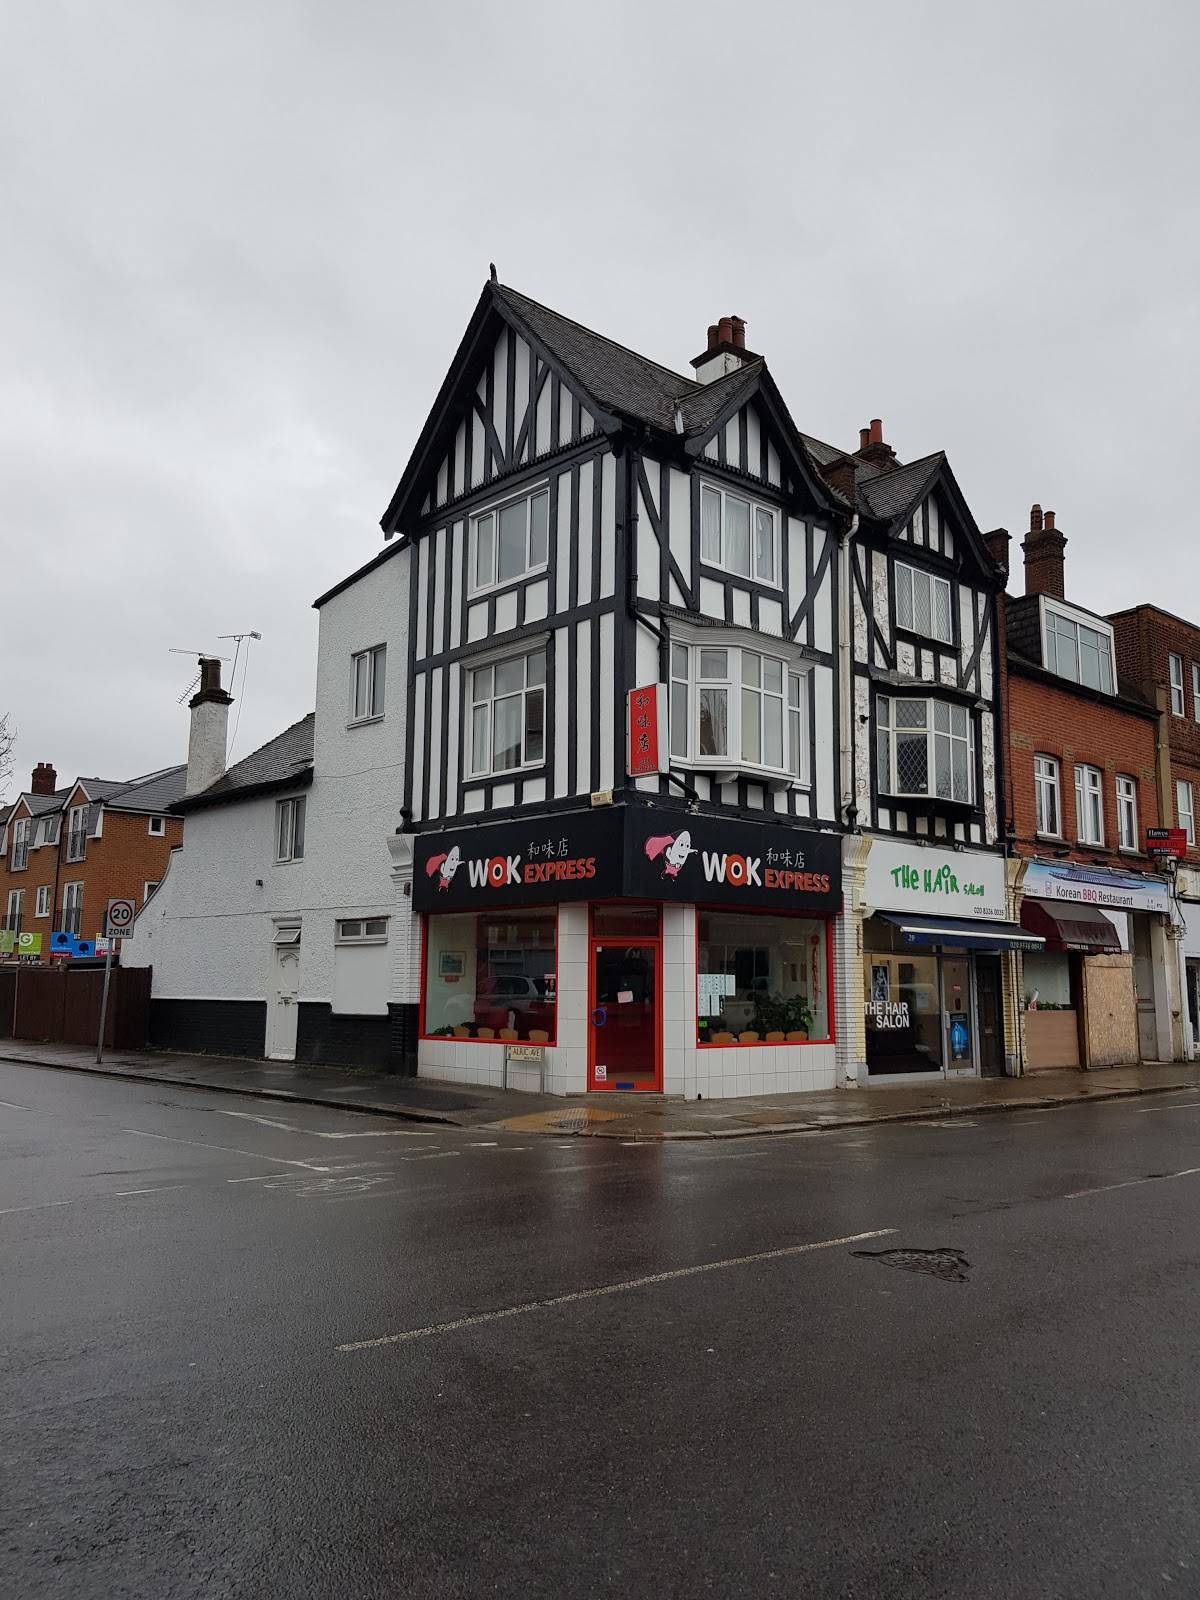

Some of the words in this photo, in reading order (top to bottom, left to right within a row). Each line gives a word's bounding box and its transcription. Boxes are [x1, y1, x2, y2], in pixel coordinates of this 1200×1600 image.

[527, 838, 569, 860] 和味店
[766, 847, 805, 869] 和味店
[468, 855, 522, 888] WOK
[524, 857, 596, 884] EXPRESS
[702, 851, 762, 887] WOK
[764, 868, 831, 893] EXPRESS
[1056, 885, 1082, 900] Korean
[1082, 889, 1098, 902] BBQ
[1098, 890, 1134, 906] Restaurant
[112, 909, 129, 919] 20
[108, 928, 130, 936] ZONE
[864, 1002, 883, 1015] THE
[885, 1002, 909, 1015] HAIR
[876, 1015, 910, 1028] SALON
